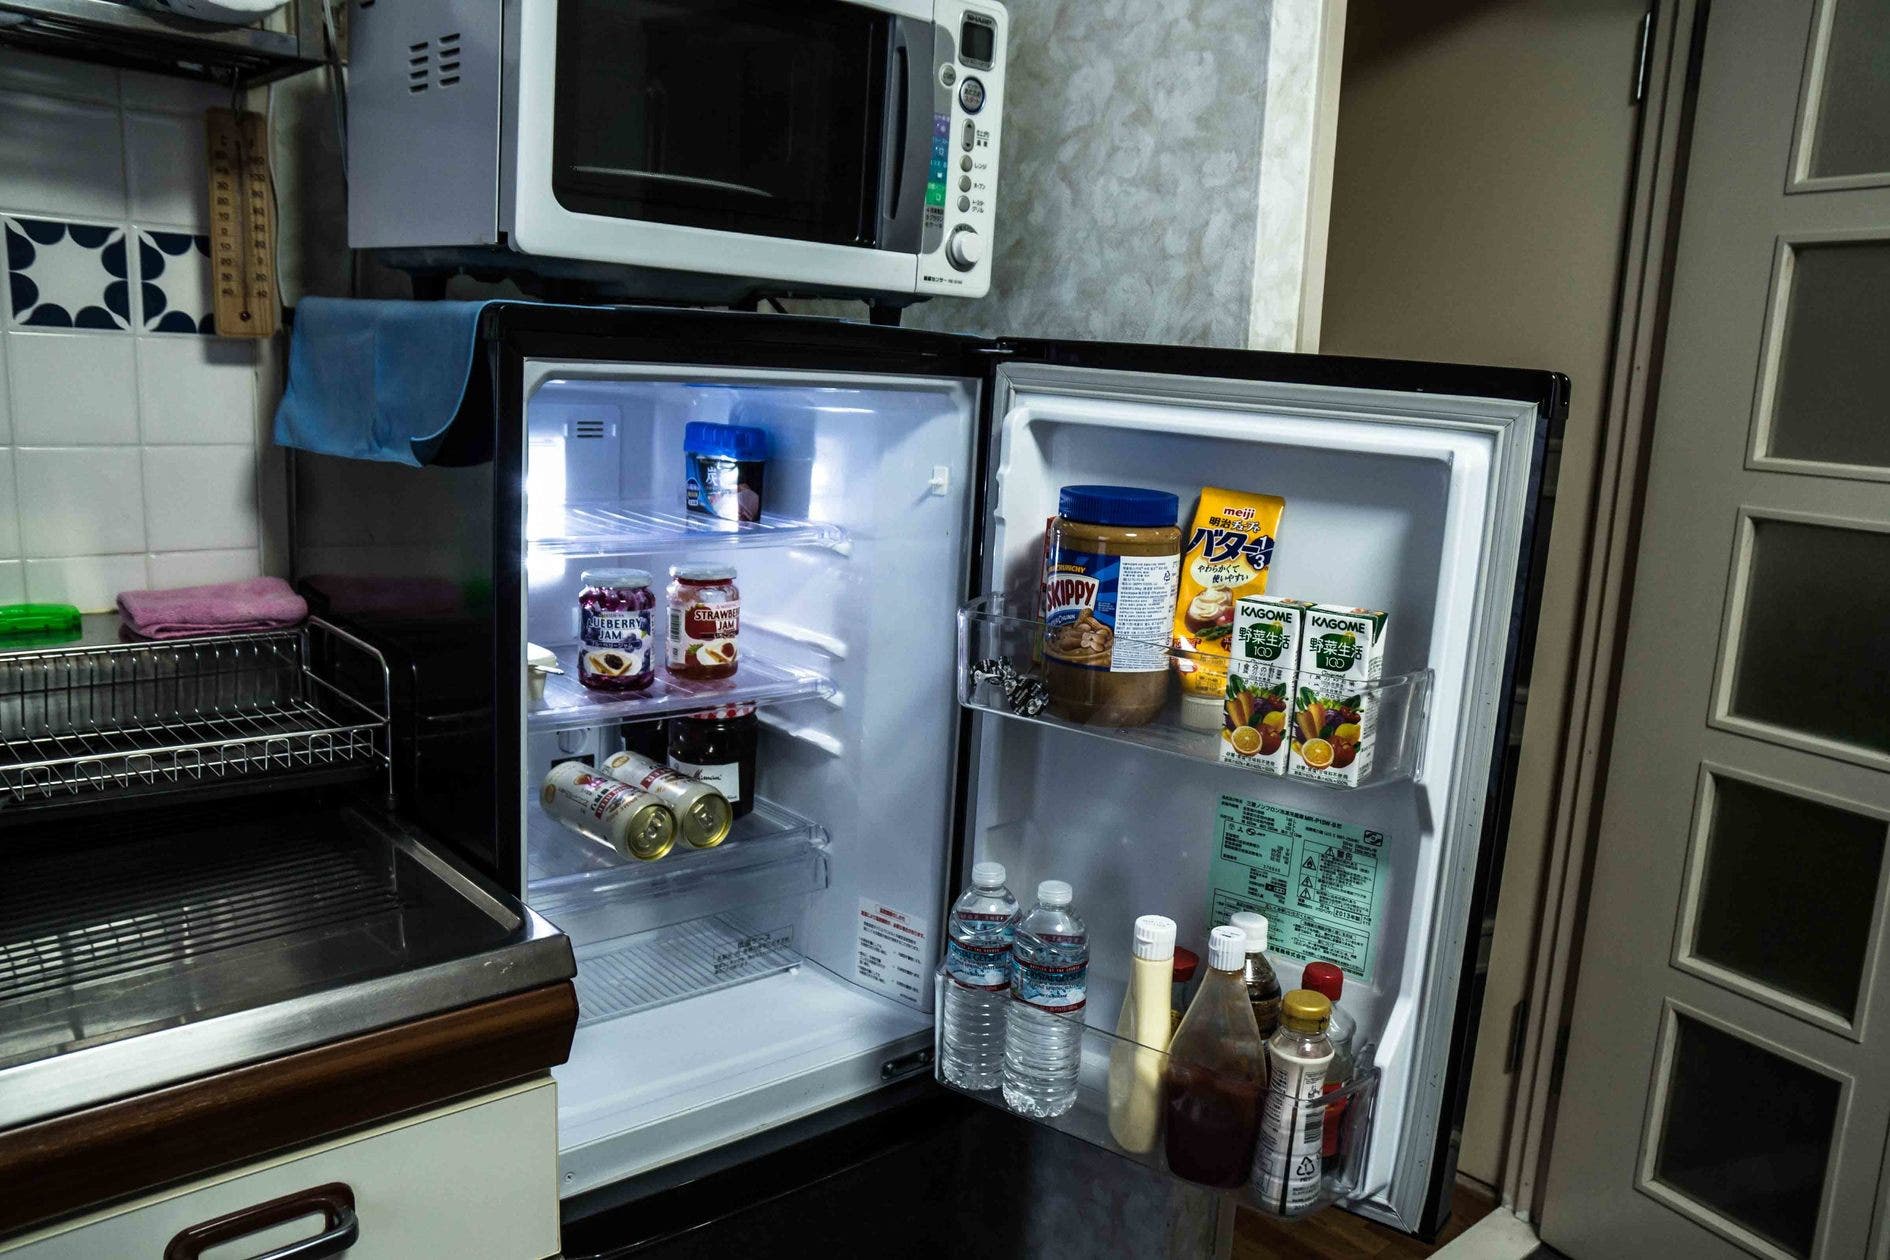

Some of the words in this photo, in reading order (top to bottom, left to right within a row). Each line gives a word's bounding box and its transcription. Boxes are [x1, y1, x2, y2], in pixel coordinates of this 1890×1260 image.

[1223, 507, 1256, 520] meiji
[1198, 564, 1241, 574] やわらかくて
[1241, 605, 1293, 624] KAGOME
[718, 619, 736, 632] JAM
[1311, 616, 1366, 634] KAGOME
[600, 629, 623, 641] JAM
[1238, 626, 1291, 650] 野菜生活
[1254, 645, 1273, 658] 100
[1309, 637, 1363, 661] 野菜生活
[1325, 656, 1345, 669] 100
